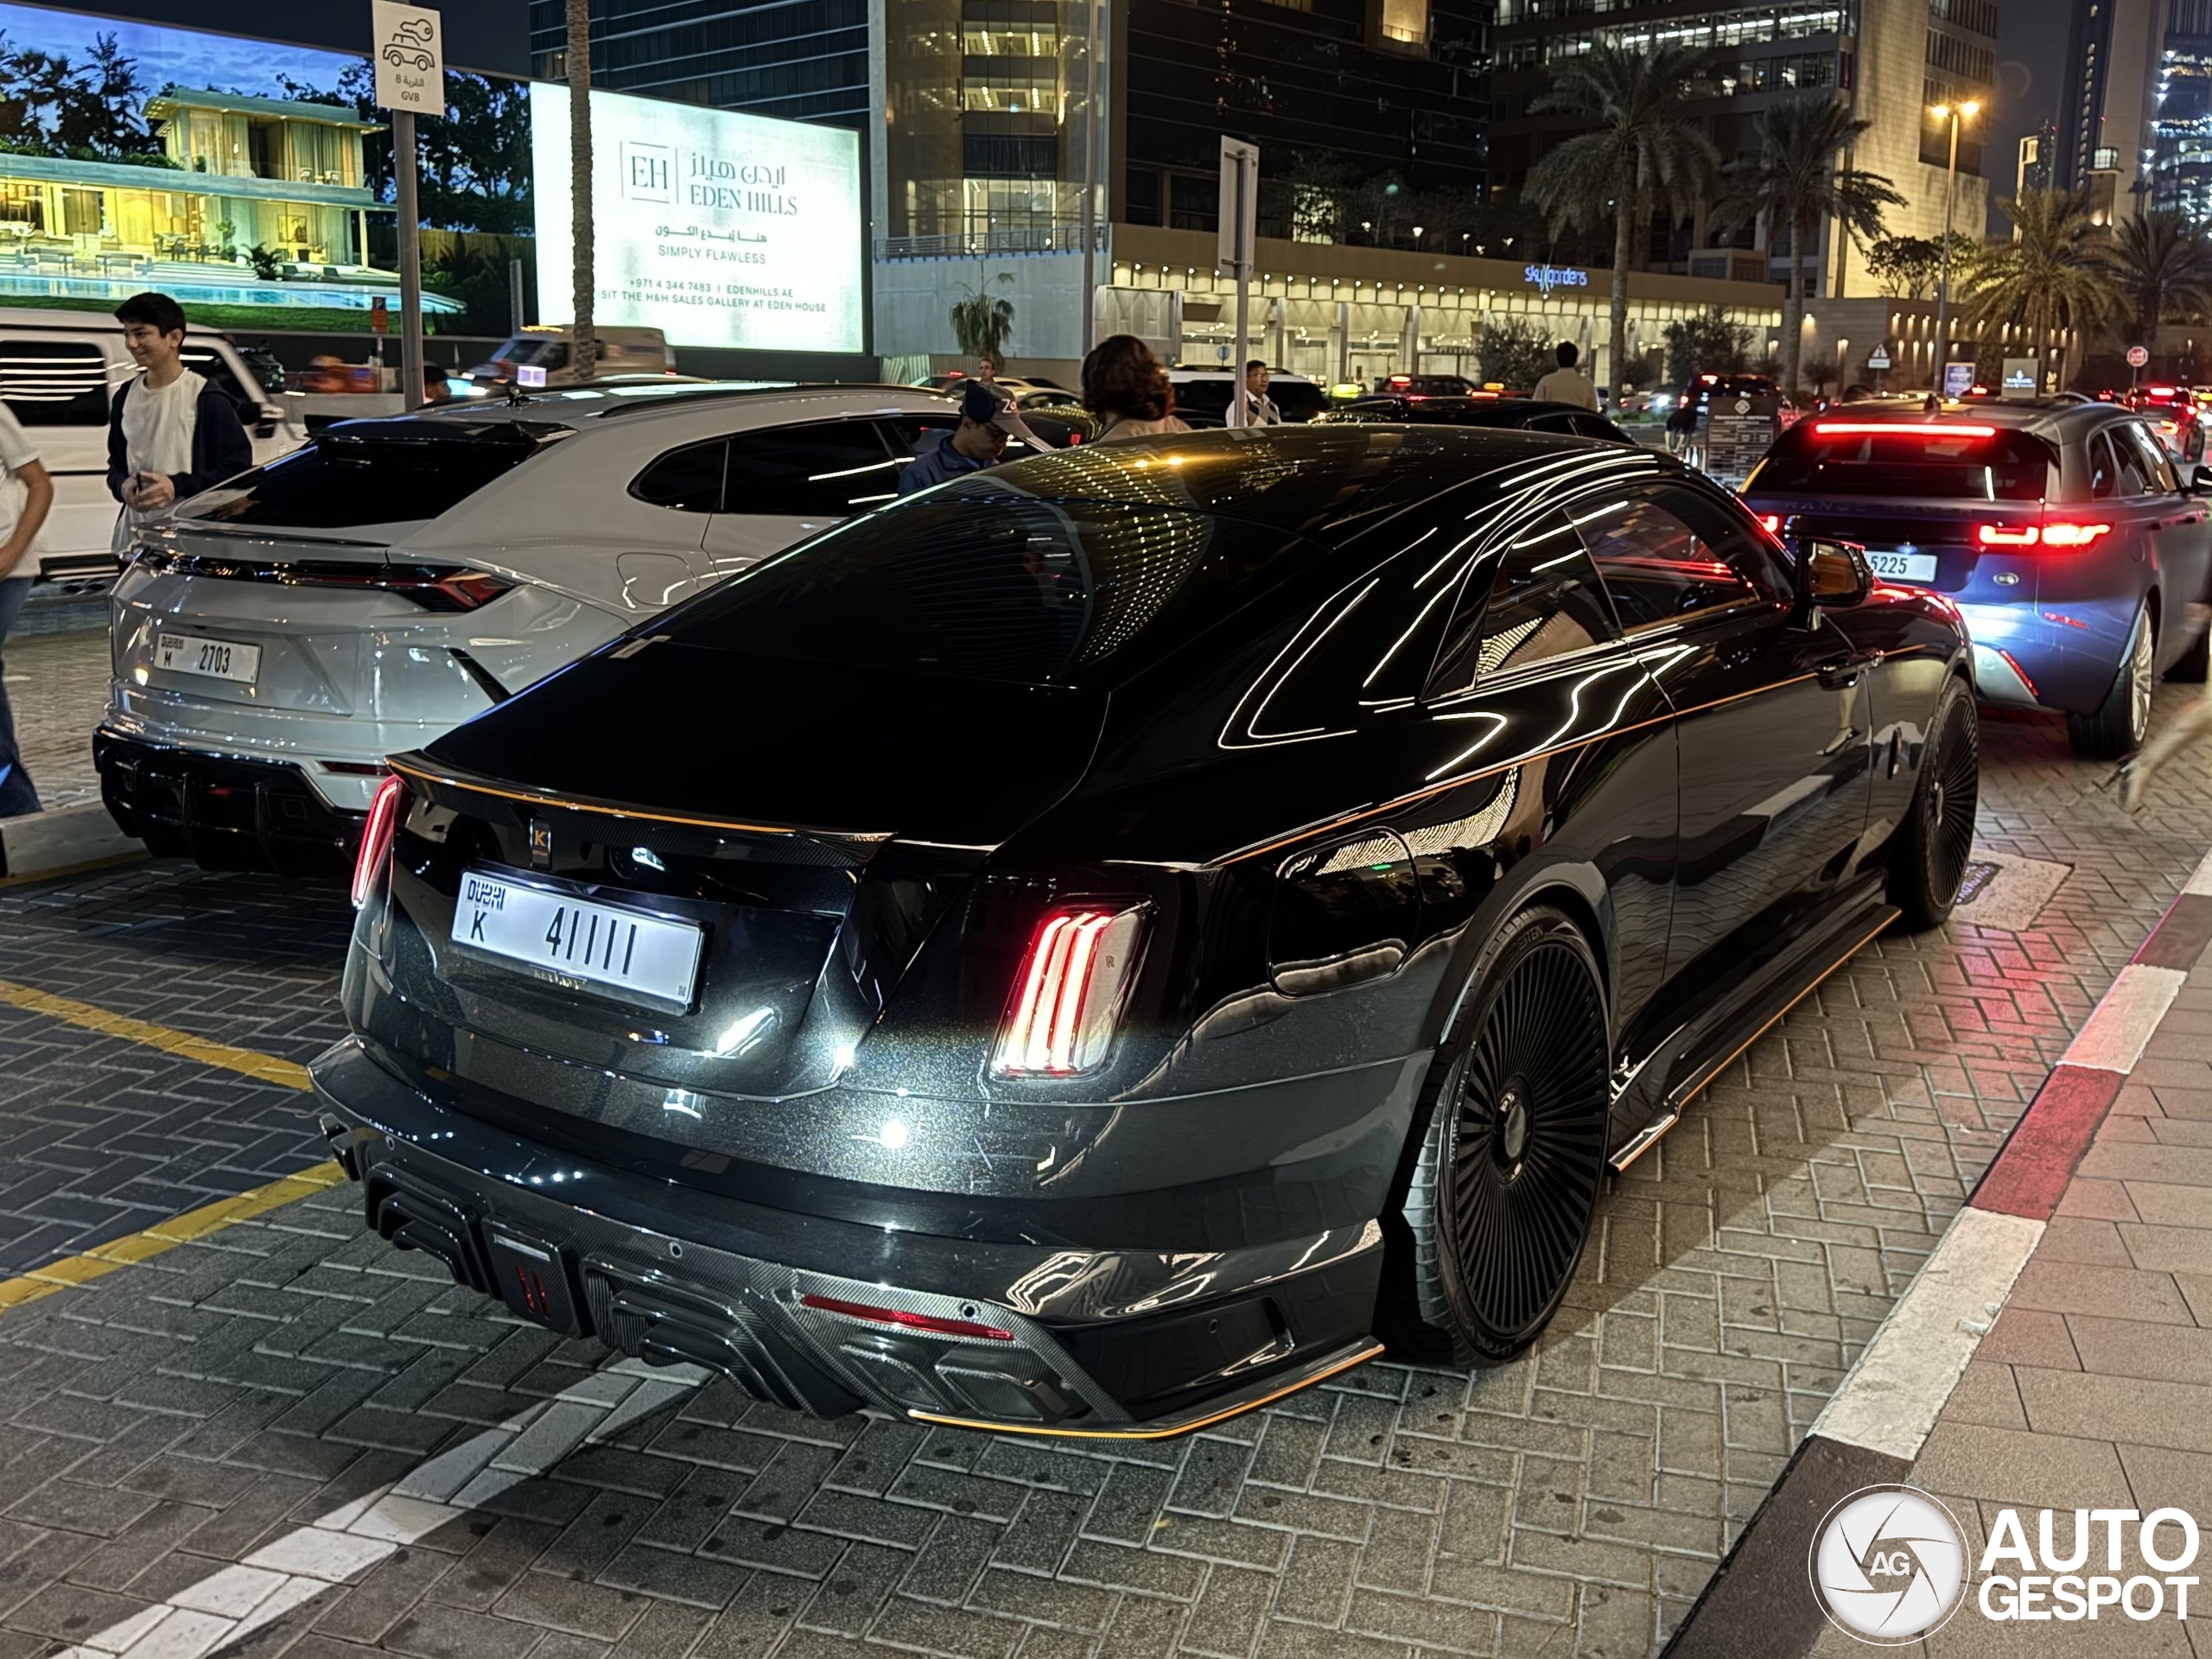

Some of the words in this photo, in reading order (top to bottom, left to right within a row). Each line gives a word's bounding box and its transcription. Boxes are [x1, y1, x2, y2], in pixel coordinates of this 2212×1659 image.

[396, 74, 402, 84] 8
[401, 91, 420, 102] GV8
[632, 156, 668, 189] EH
[690, 184, 741, 209] EDEN
[747, 191, 798, 216] HILLS
[658, 245, 702, 259] SIMPLY
[706, 248, 766, 264] FLAWLESS
[630, 278, 652, 289] +971
[666, 280, 684, 290] 344
[688, 282, 711, 293] 7483
[621, 290, 643, 302] THE
[672, 294, 703, 306] SALES
[707, 296, 750, 308] GALLERY
[753, 299, 764, 308] AT
[768, 300, 792, 311] EDEN
[795, 302, 826, 313] HOUSE
[1871, 556, 1908, 575] 5225
[164, 651, 172, 667] M
[199, 644, 231, 674] 2703
[534, 830, 548, 847] K
[471, 910, 487, 942] K
[546, 906, 637, 976] 41111
